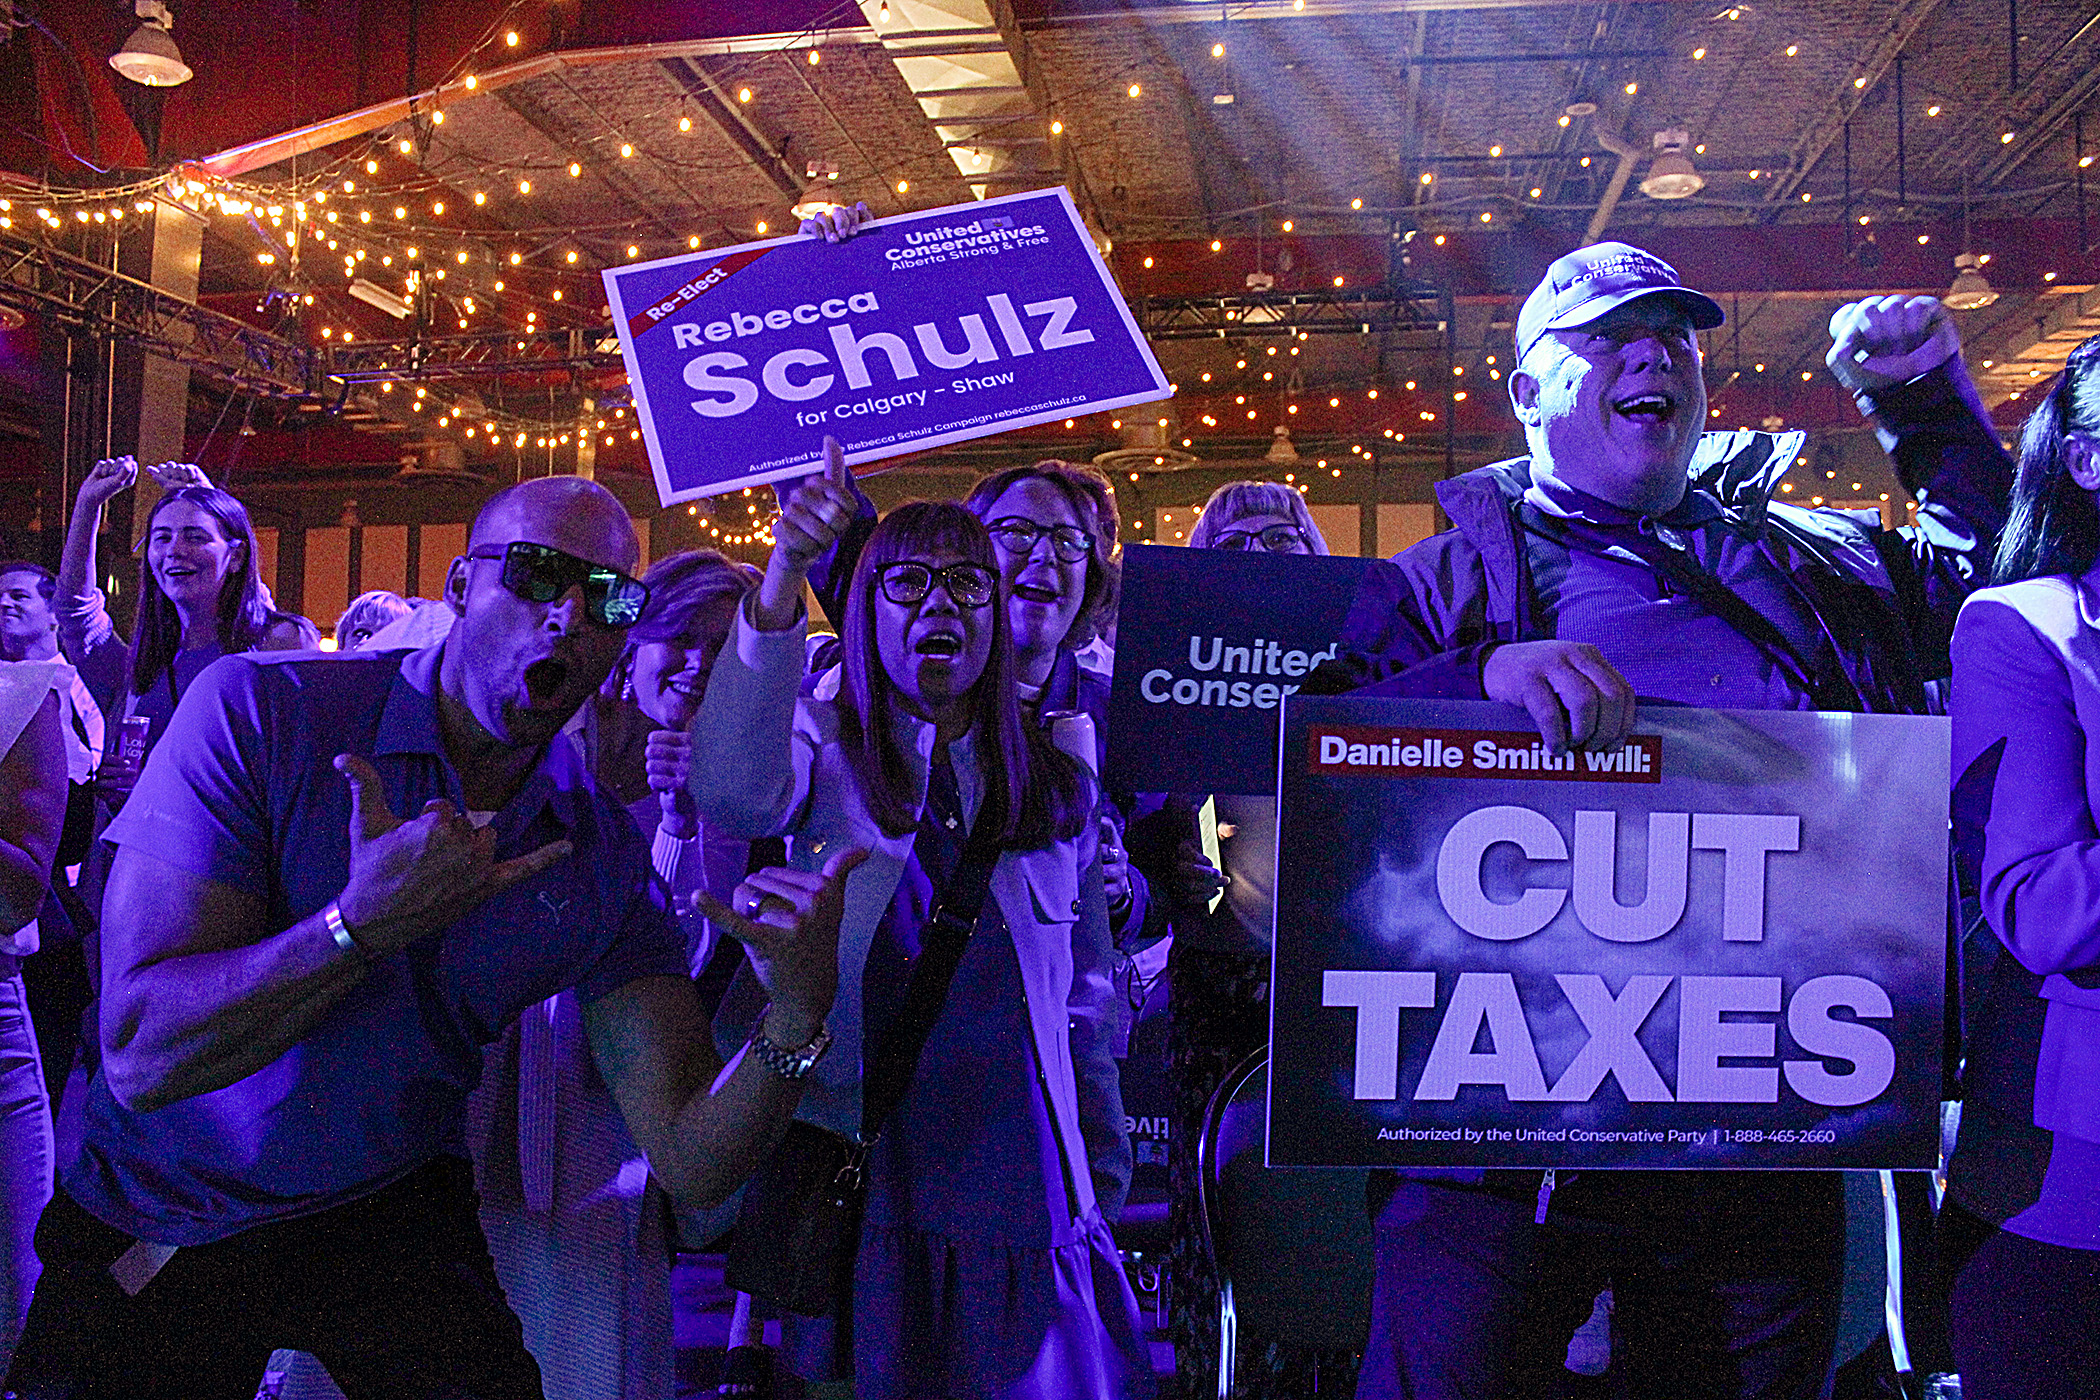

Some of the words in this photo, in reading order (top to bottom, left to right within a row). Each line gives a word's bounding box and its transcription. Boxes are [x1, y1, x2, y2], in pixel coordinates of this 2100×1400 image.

[885, 225, 1047, 261] Conservatives
[891, 253, 946, 271] Alberta
[950, 244, 999, 260] Strong
[1002, 241, 1014, 250] &
[1016, 236, 1049, 248] Free
[904, 221, 983, 245] United
[1586, 254, 1644, 271] United
[646, 266, 728, 322] Re-Elect
[672, 292, 880, 350] Rebecca
[682, 292, 1096, 419] Schulz
[796, 411, 828, 427] for
[833, 388, 927, 420] Calgary
[952, 372, 1014, 394] Shaw
[749, 453, 808, 472] Authorized
[810, 450, 824, 460] by
[846, 434, 896, 452] Rebecca
[897, 427, 932, 440] Schulz
[934, 413, 992, 432] Campaign
[994, 394, 1087, 418] rebeccaschulz.ca
[1320, 735, 1464, 768] Danielle
[1585, 744, 1651, 773] will:
[1436, 805, 1800, 942] CUT
[1322, 970, 1895, 1106] TAXES
[1376, 1128, 1462, 1142] Authorized
[1464, 1128, 1484, 1144] by
[1486, 1128, 1512, 1142] the
[1516, 1128, 1566, 1142] United
[1570, 1129, 1664, 1142] Conservative
[1668, 1130, 1706, 1144] Party
[1724, 1130, 1836, 1143] 1-888-465-2660
